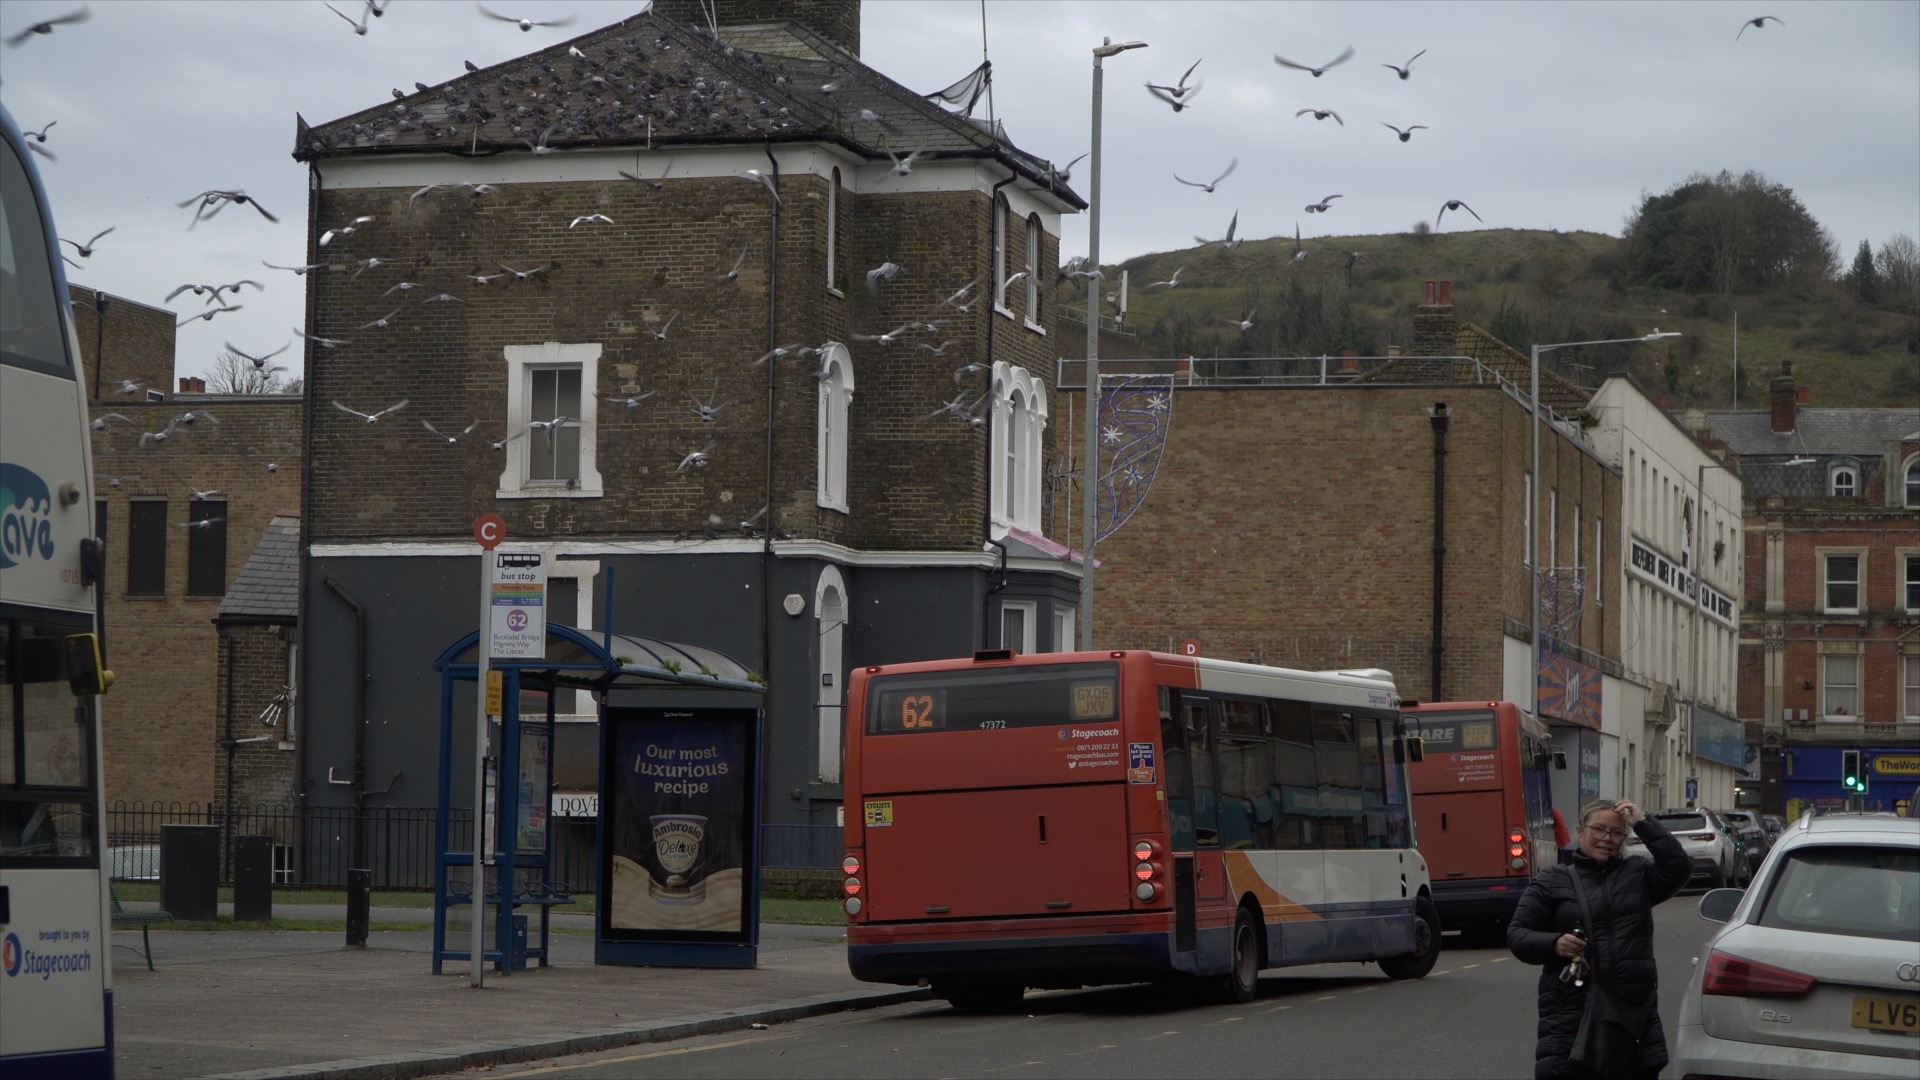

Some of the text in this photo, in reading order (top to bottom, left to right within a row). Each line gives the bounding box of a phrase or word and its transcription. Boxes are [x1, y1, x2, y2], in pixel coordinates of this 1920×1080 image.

[481, 522, 497, 541] C
[501, 572, 536, 581] bus stop
[507, 613, 527, 627] 62
[521, 633, 540, 642] Bridge
[516, 641, 530, 649] Way
[1077, 686, 1110, 700] GX06
[902, 695, 933, 728] 62
[980, 720, 1006, 730] 47372
[1071, 728, 1119, 739] Stagecoach
[646, 744, 719, 760] Our most
[1066, 752, 1119, 761] stagecoachbus.com
[1460, 754, 1495, 762] Stagecoach
[634, 754, 729, 778] luxurious
[654, 779, 710, 799] recipe
[654, 821, 702, 840] Ambrosia
[39, 929, 90, 942] brought to you by
[24, 949, 91, 980] Stagecoach
[1760, 1009, 1792, 1023] Q3
